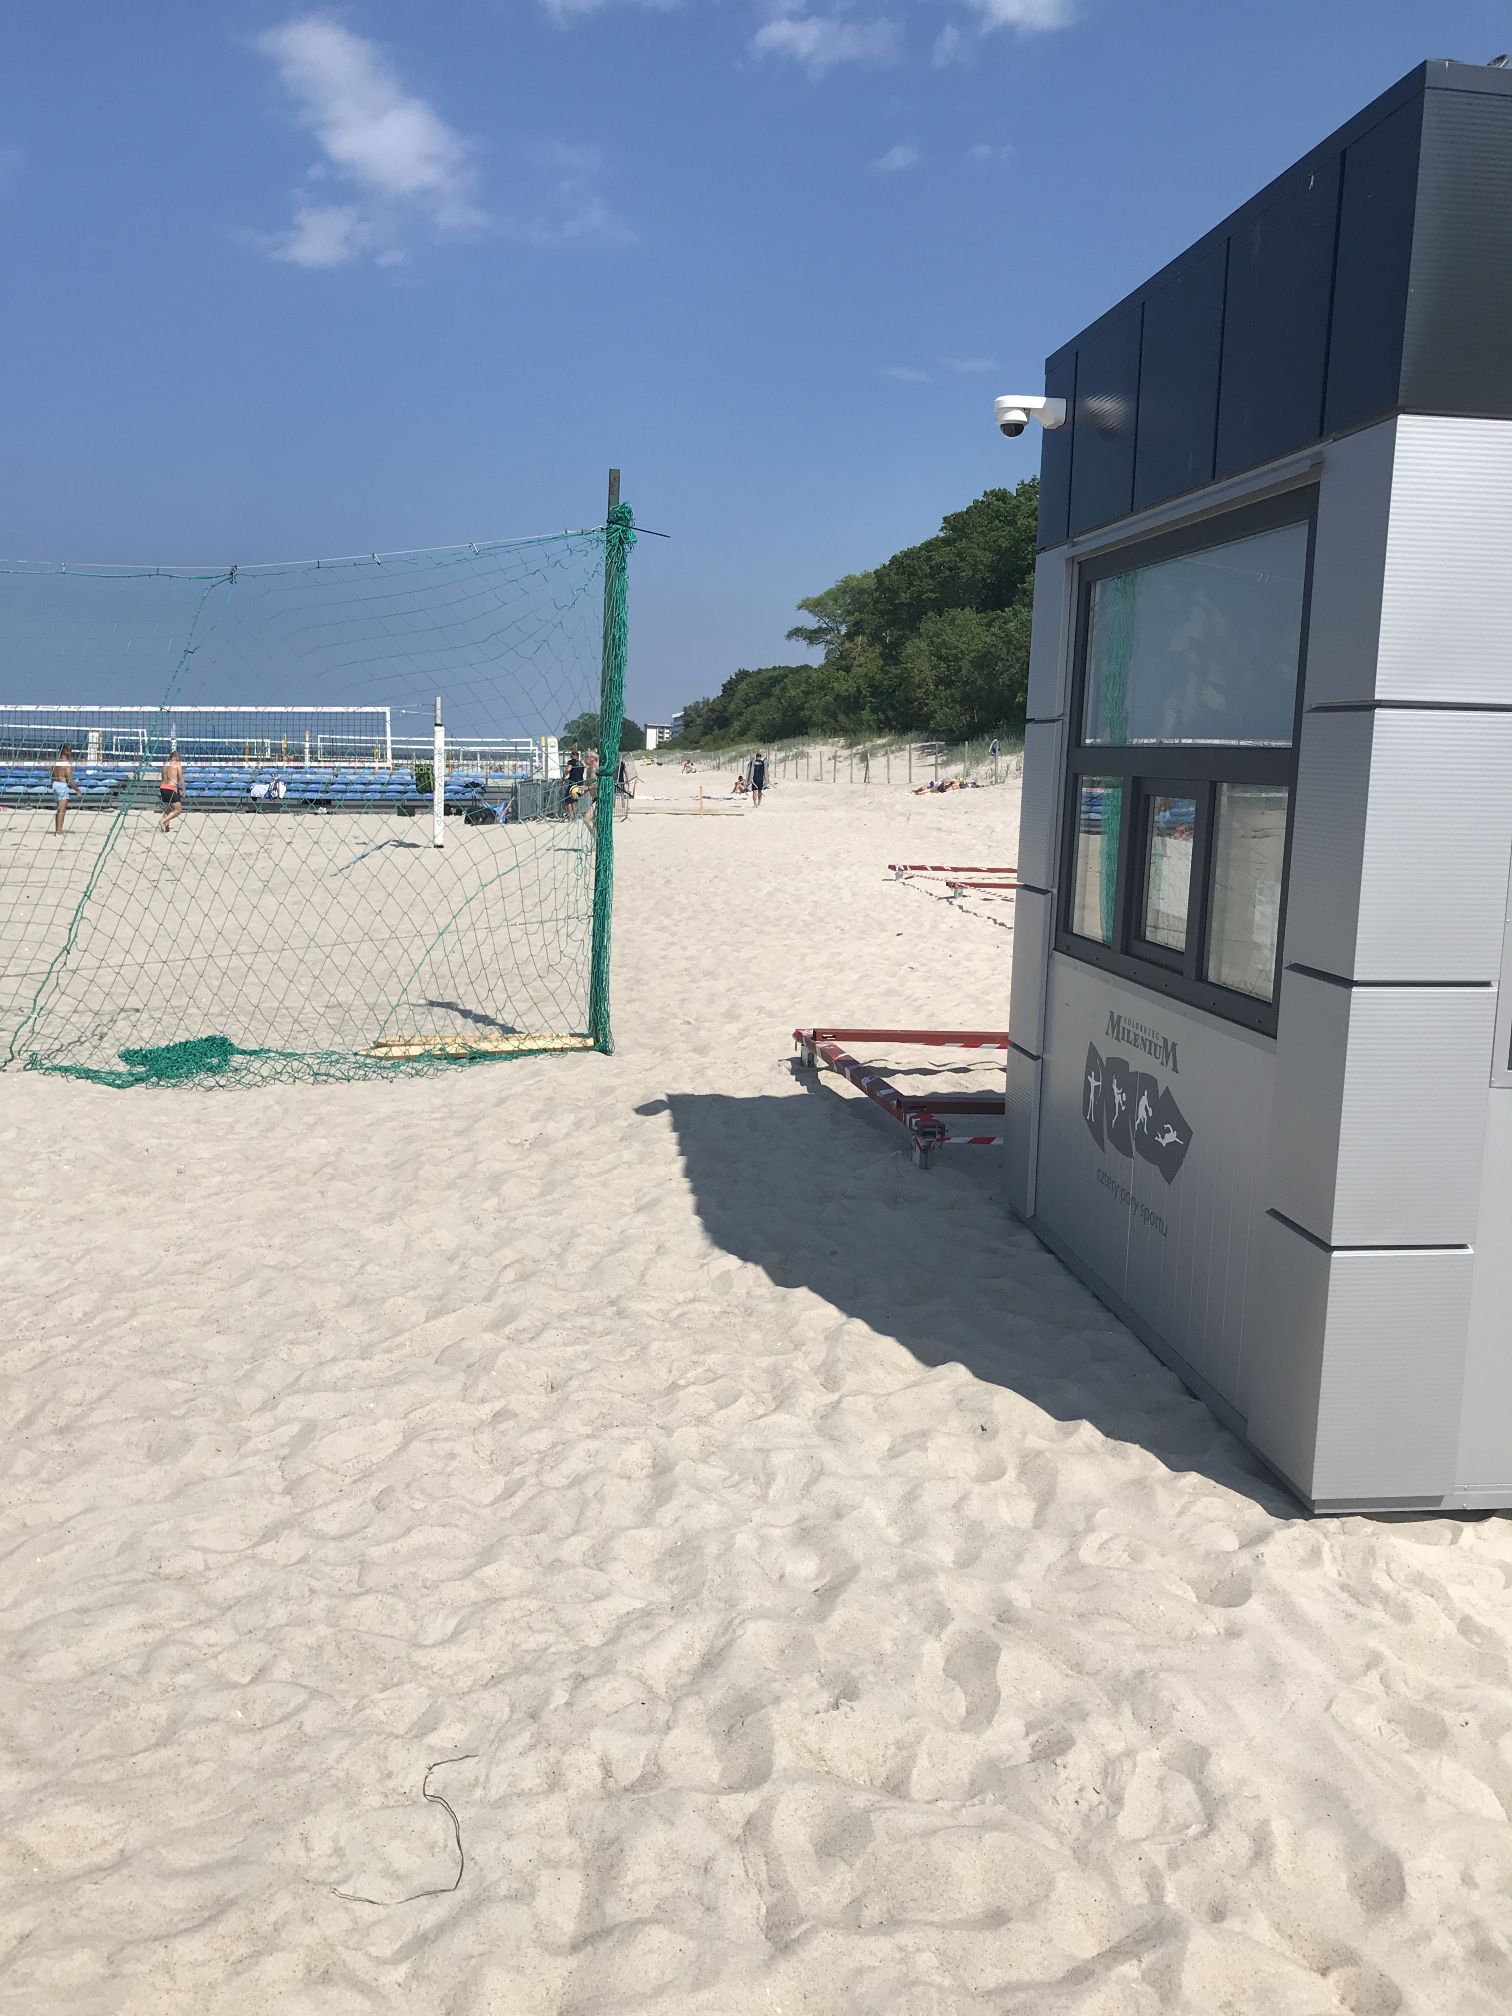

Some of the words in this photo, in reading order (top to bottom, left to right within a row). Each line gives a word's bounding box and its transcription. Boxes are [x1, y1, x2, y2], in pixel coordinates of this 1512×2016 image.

[1105, 1010, 1179, 1074] MILENIUM
[1097, 1168, 1119, 1200] cztery
[1120, 1188, 1139, 1216] pory
[1140, 1203, 1168, 1237] sportu
